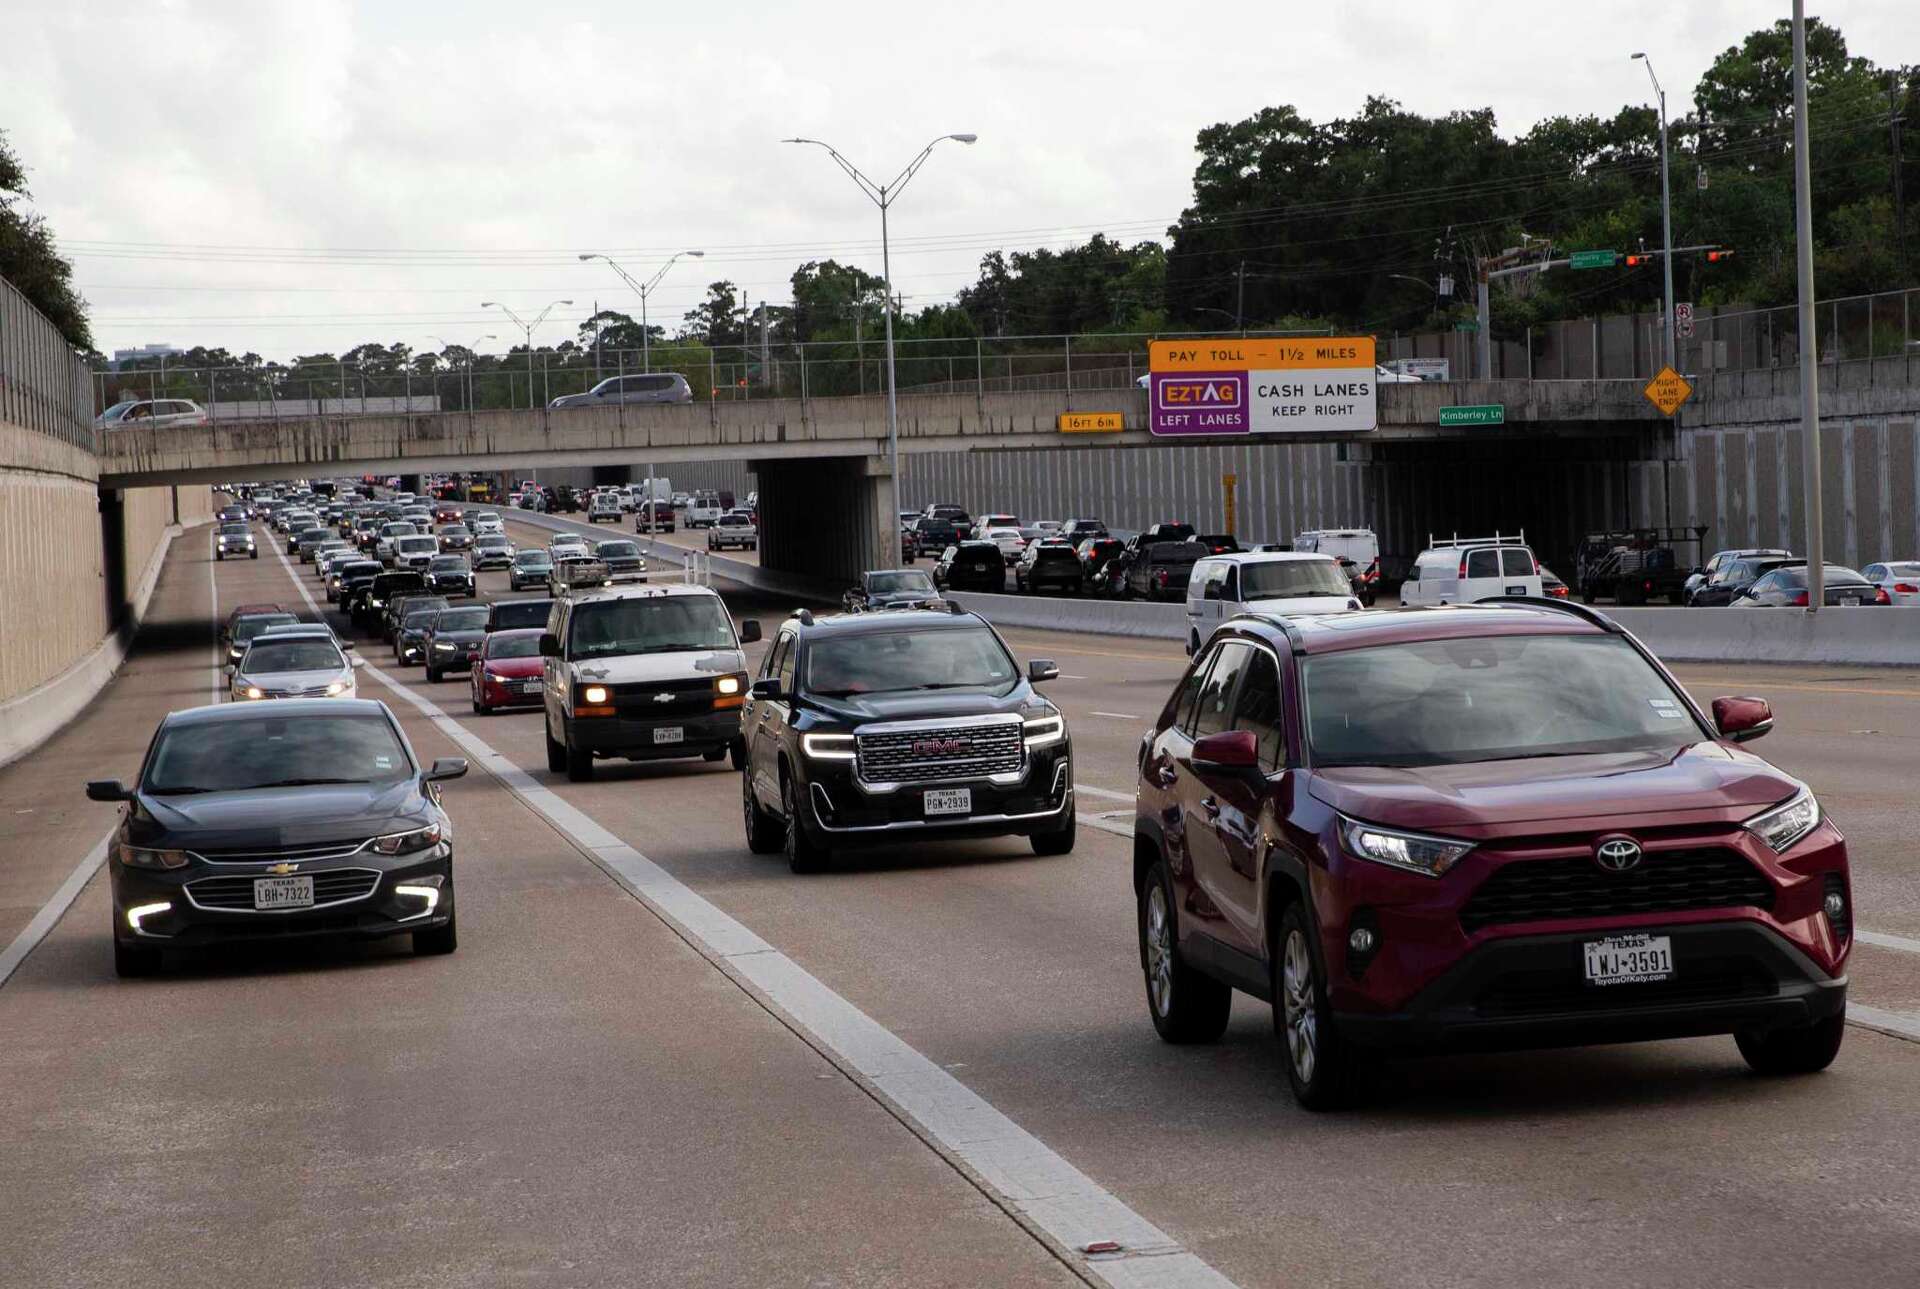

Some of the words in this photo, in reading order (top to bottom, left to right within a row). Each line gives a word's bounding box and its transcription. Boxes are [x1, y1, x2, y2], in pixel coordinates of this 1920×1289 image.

[1169, 351, 1197, 361] PAY
[1210, 349, 1244, 361] TOLL
[1316, 347, 1357, 360] MILES
[1166, 382, 1234, 403] EZTAG
[1258, 384, 1304, 398] CASH
[1314, 383, 1370, 397] LANES
[1658, 398, 1681, 406] ENDS
[1272, 405, 1306, 416] KEEP
[1315, 404, 1355, 416] RIGHT
[1441, 411, 1487, 420] Kimberley
[1491, 409, 1502, 419] Ln
[1159, 414, 1191, 427] LEFT
[1199, 413, 1242, 426] LANES
[1612, 939, 1646, 950] TEXAS
